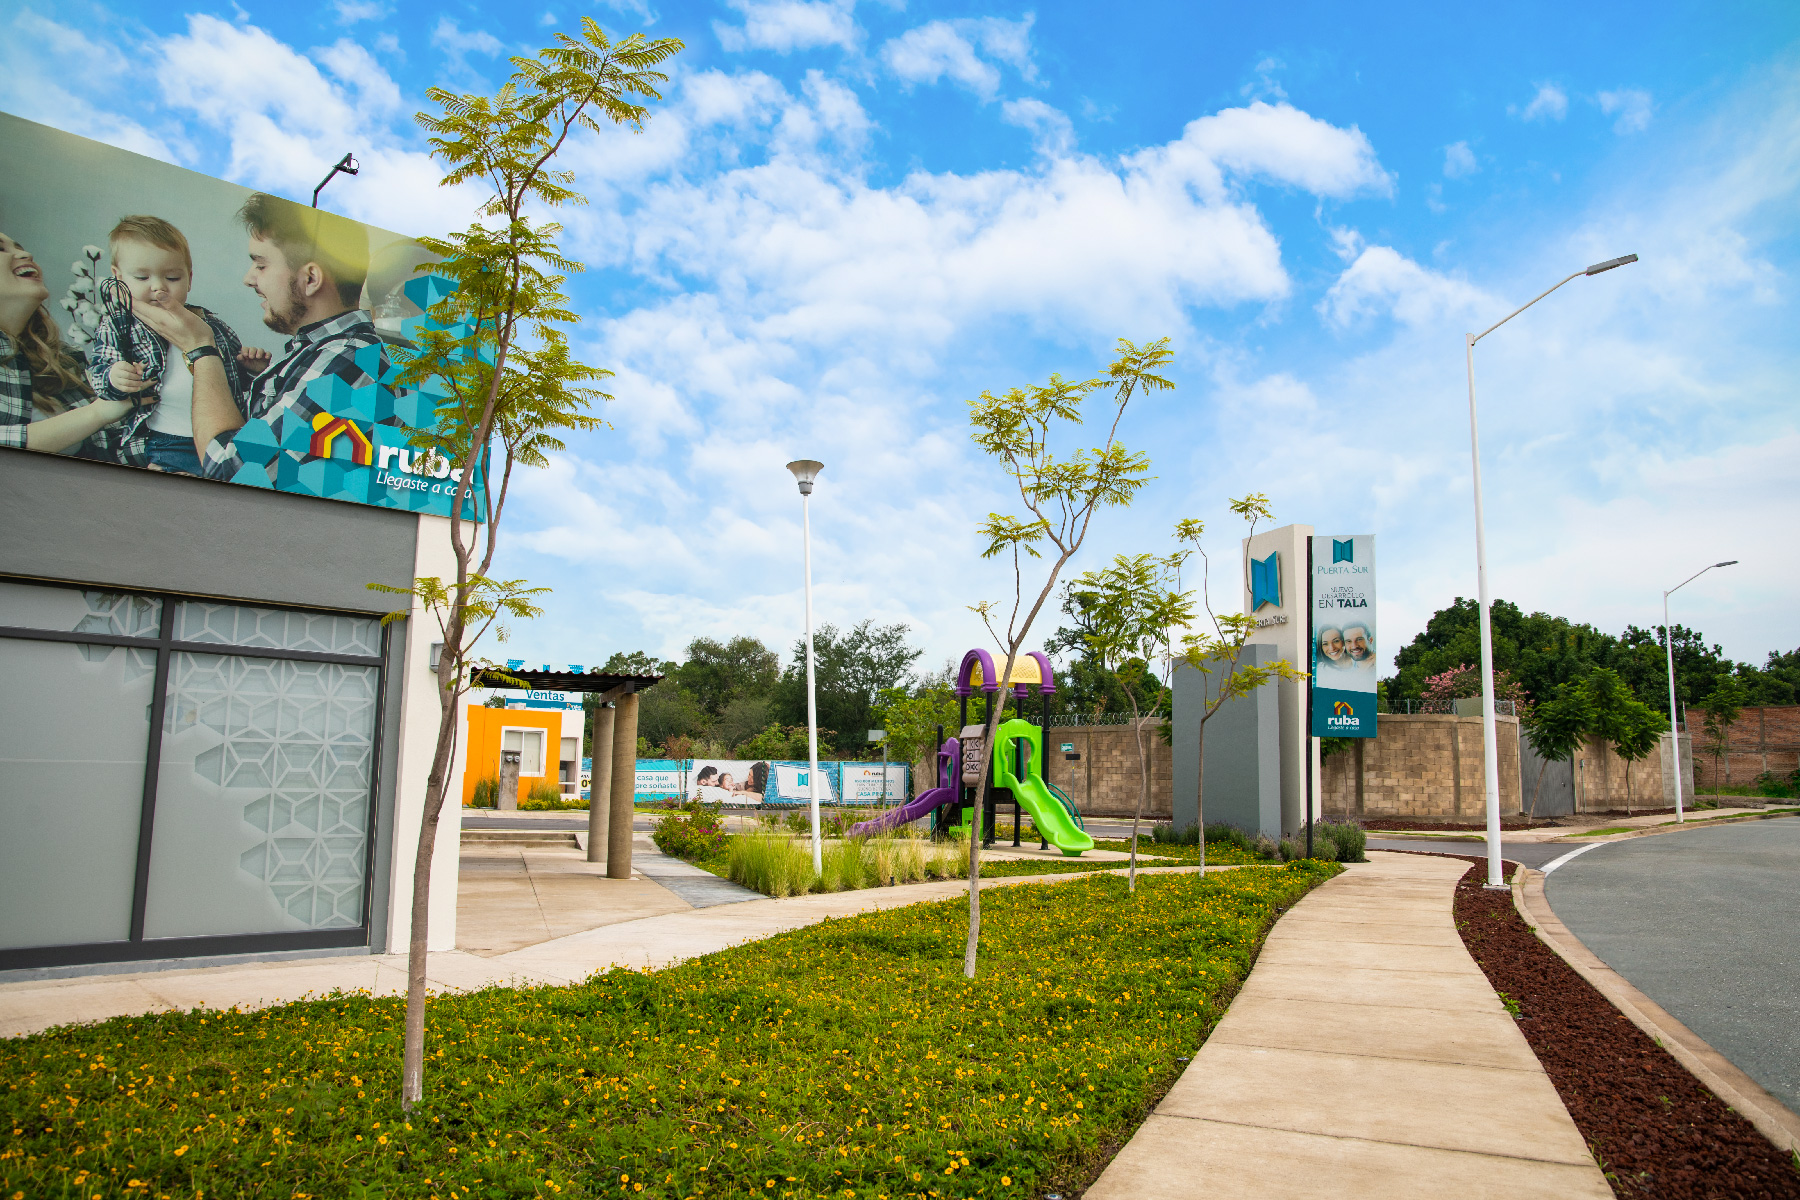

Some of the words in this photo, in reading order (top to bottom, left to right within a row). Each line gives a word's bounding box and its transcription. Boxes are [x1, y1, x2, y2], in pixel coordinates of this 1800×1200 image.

[376, 471, 428, 491] Llegaste
[431, 483, 441, 494] a
[444, 485, 472, 499] caa
[1317, 566, 1349, 574] PUERTA
[1352, 565, 1368, 574] SUR
[1319, 599, 1333, 608] EN
[1337, 598, 1368, 608] TALA
[525, 689, 565, 702] Ventas
[1327, 715, 1360, 725] ruba
